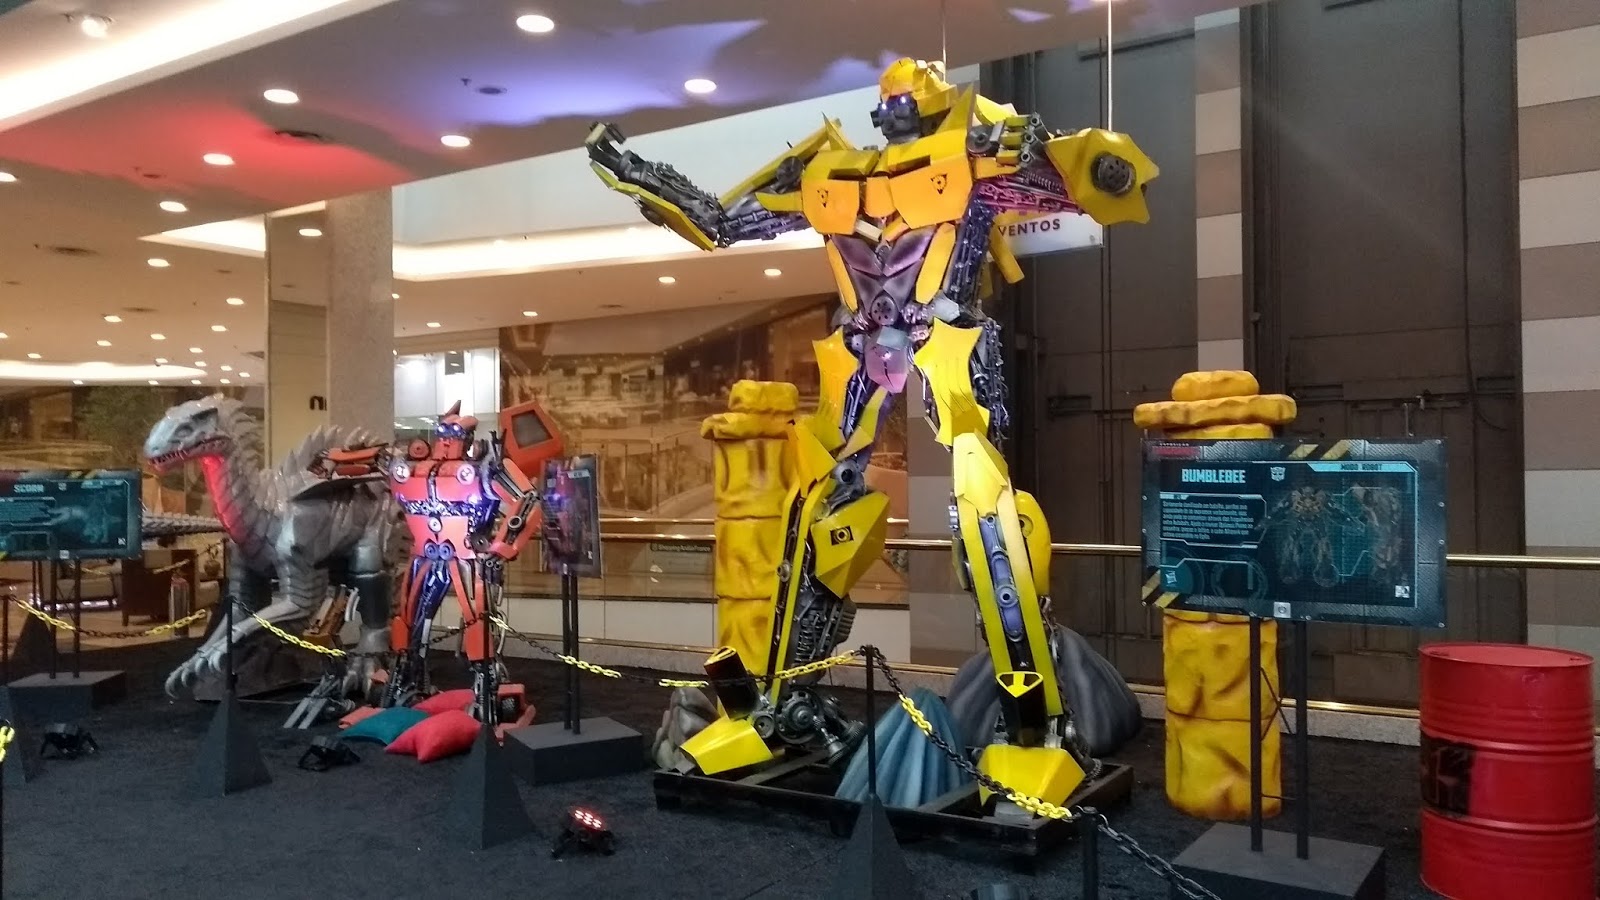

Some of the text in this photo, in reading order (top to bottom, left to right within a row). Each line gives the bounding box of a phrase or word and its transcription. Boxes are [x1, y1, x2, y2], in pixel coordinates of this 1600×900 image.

[1340, 463, 1383, 471] MODO ROBOT
[1181, 468, 1247, 484] BUMBLEBEE
[13, 484, 45, 493] SCORN
